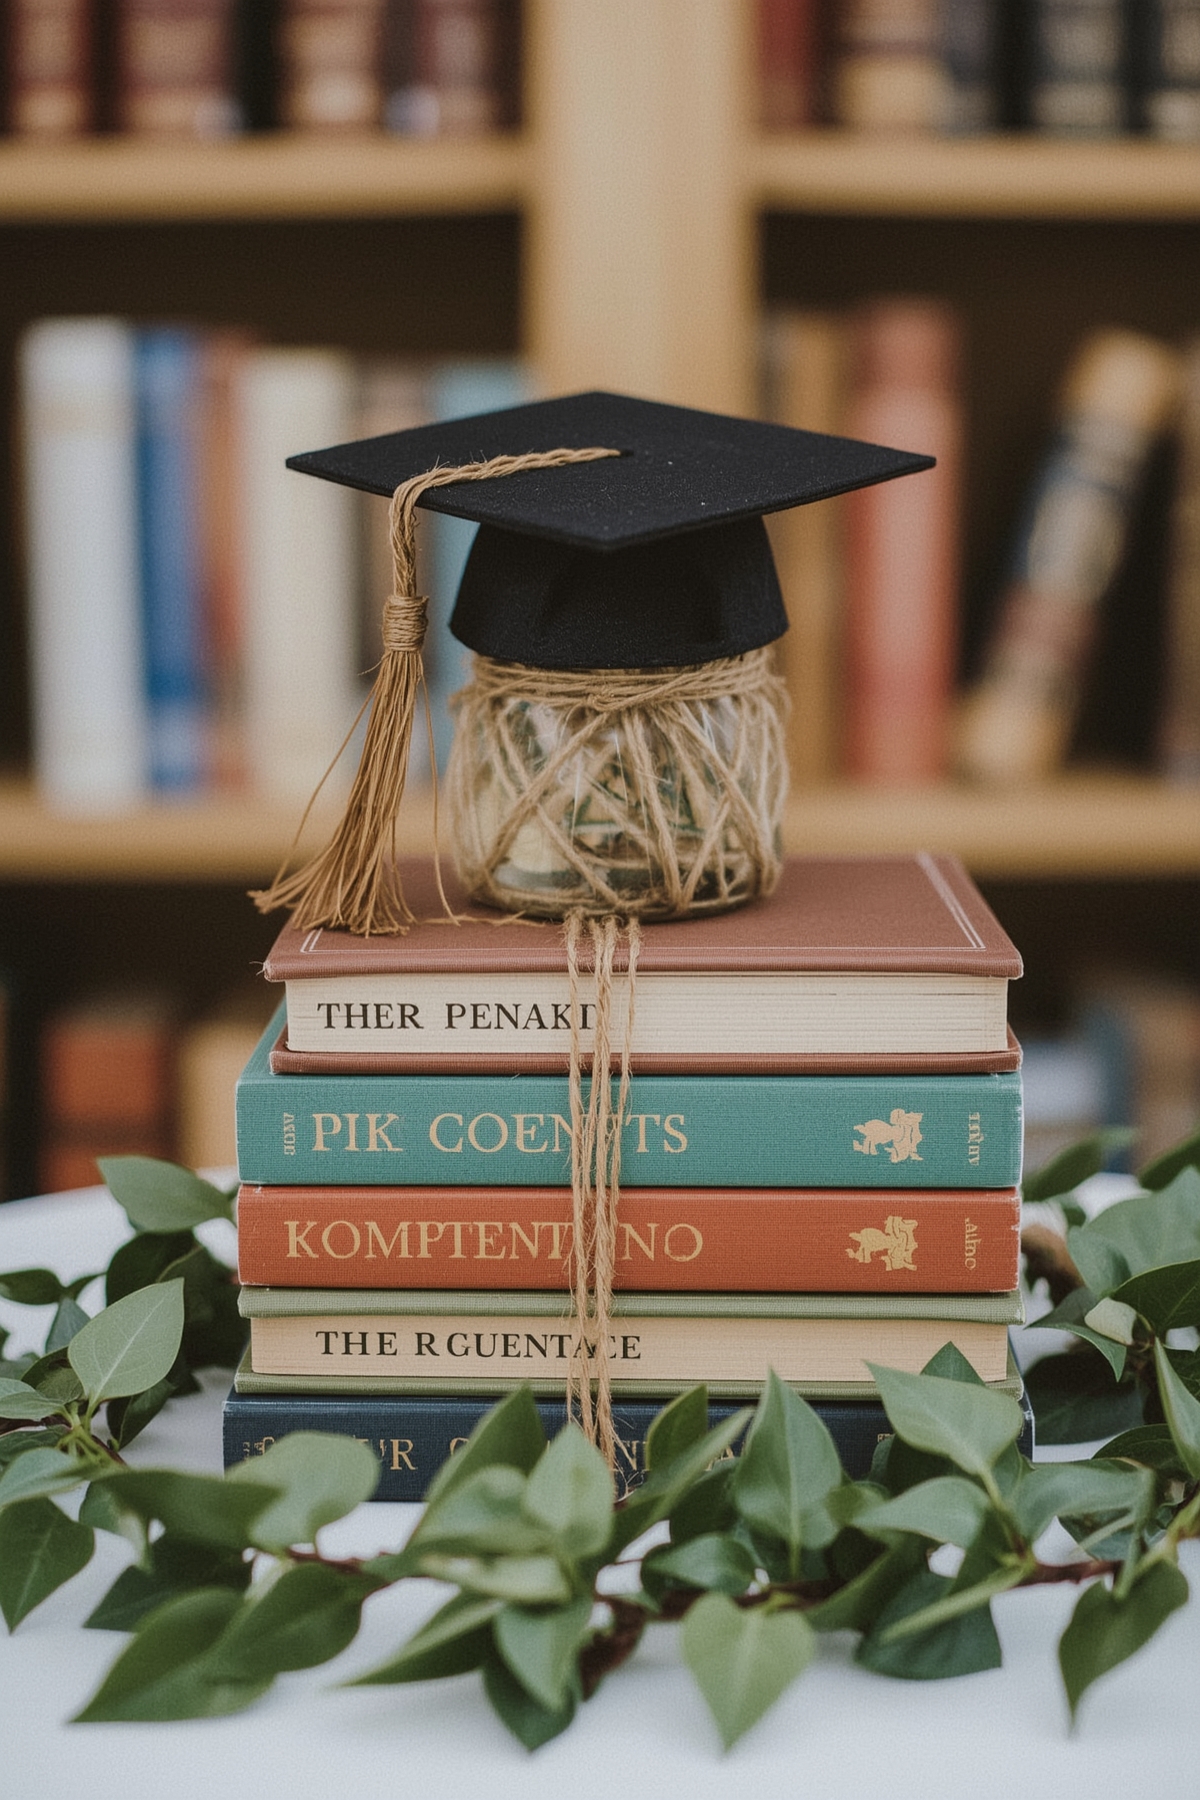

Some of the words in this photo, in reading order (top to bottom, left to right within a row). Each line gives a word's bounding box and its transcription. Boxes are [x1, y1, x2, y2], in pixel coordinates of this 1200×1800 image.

[317, 1003, 424, 1029] THER
[312, 1113, 403, 1152] PIK
[429, 1113, 688, 1154] COENTS
[315, 1331, 398, 1356] THE
